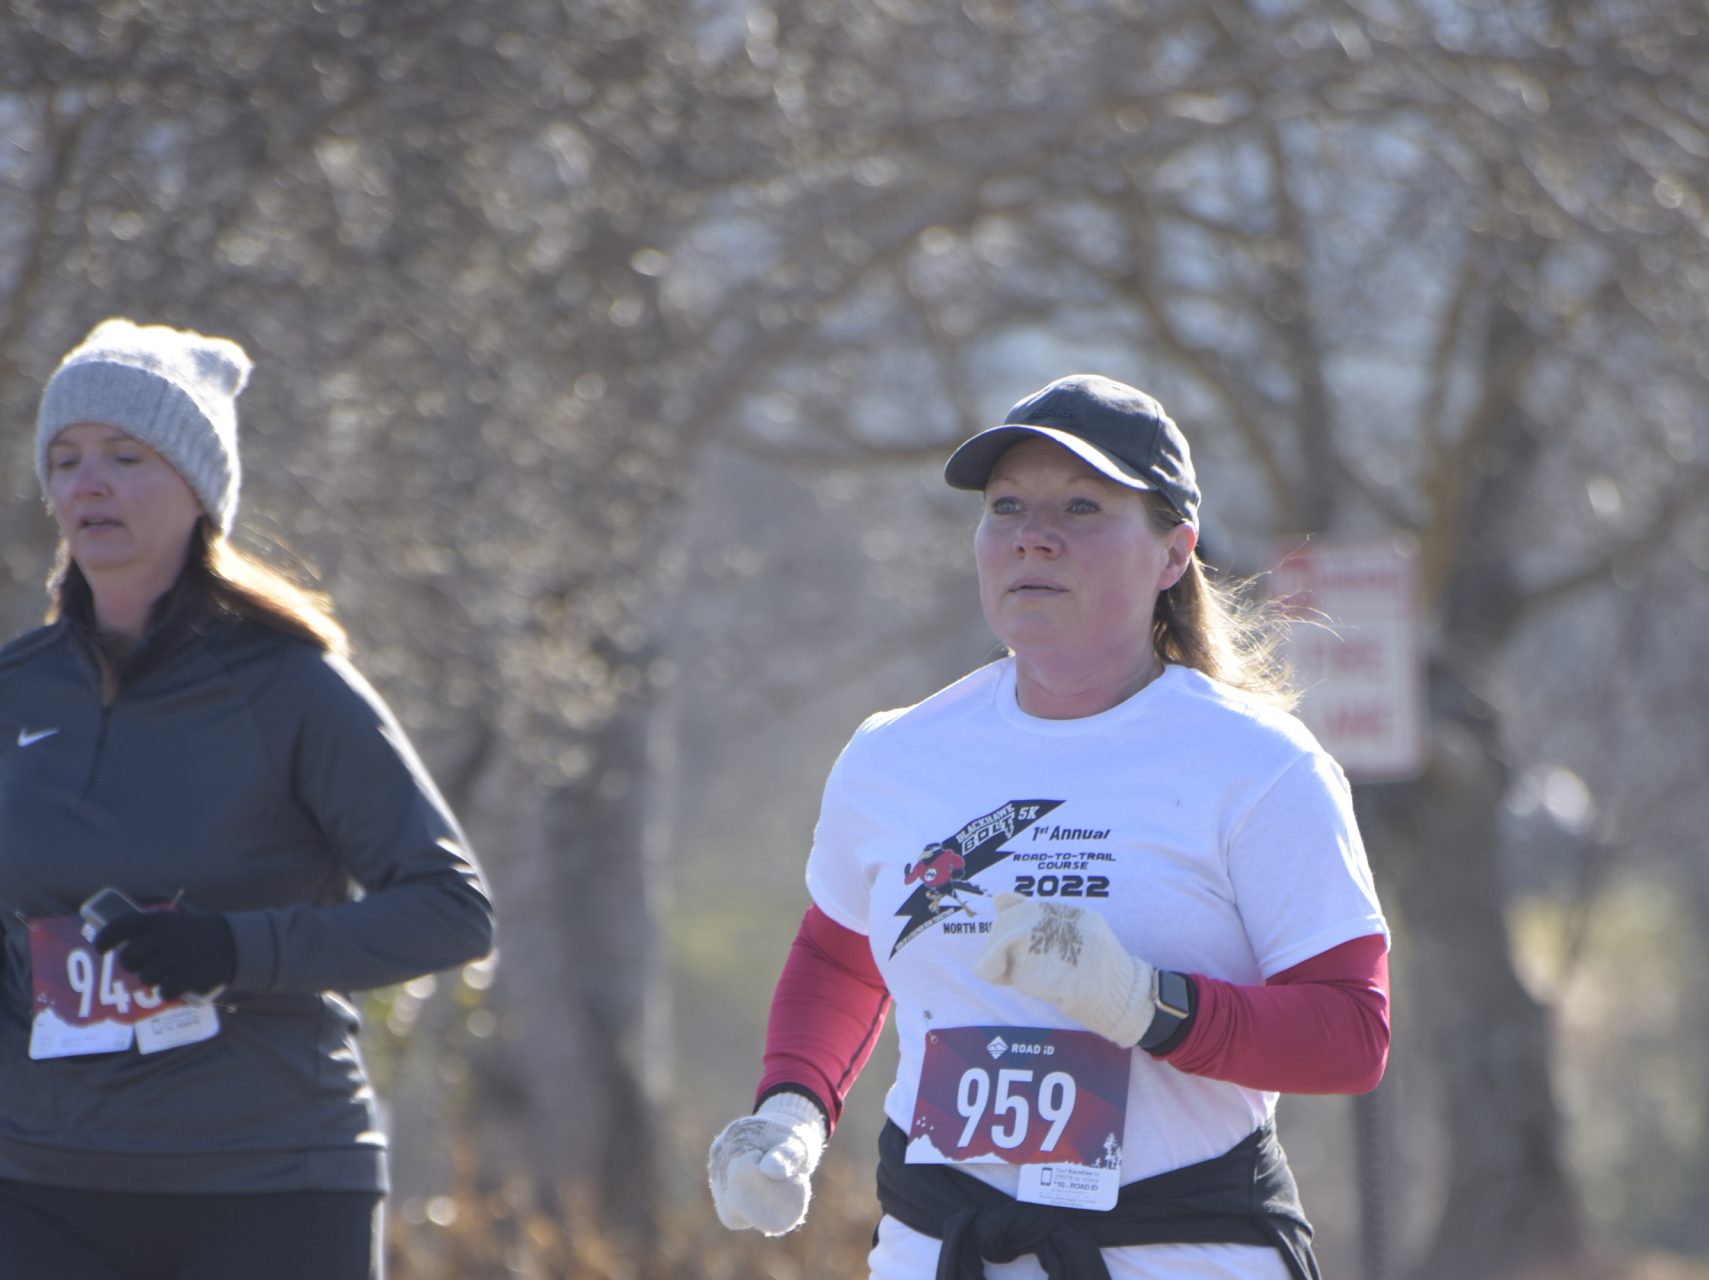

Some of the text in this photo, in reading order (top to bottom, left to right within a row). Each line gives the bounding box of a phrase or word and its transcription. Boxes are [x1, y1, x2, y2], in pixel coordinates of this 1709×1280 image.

[1018, 806, 1040, 821] 5K
[956, 803, 1015, 844] BLACKHAWK
[962, 812, 1015, 857] BOLT
[1032, 825, 1111, 842] 1st Annual
[1013, 852, 1117, 862] ROAD-TO-TRAIL
[1037, 861, 1089, 870] COURSE
[1014, 875, 1110, 898] 2022
[943, 922, 992, 935] NORTH BU
[1011, 1043, 1041, 1055] ROAD
[957, 1067, 1077, 1153] 959
